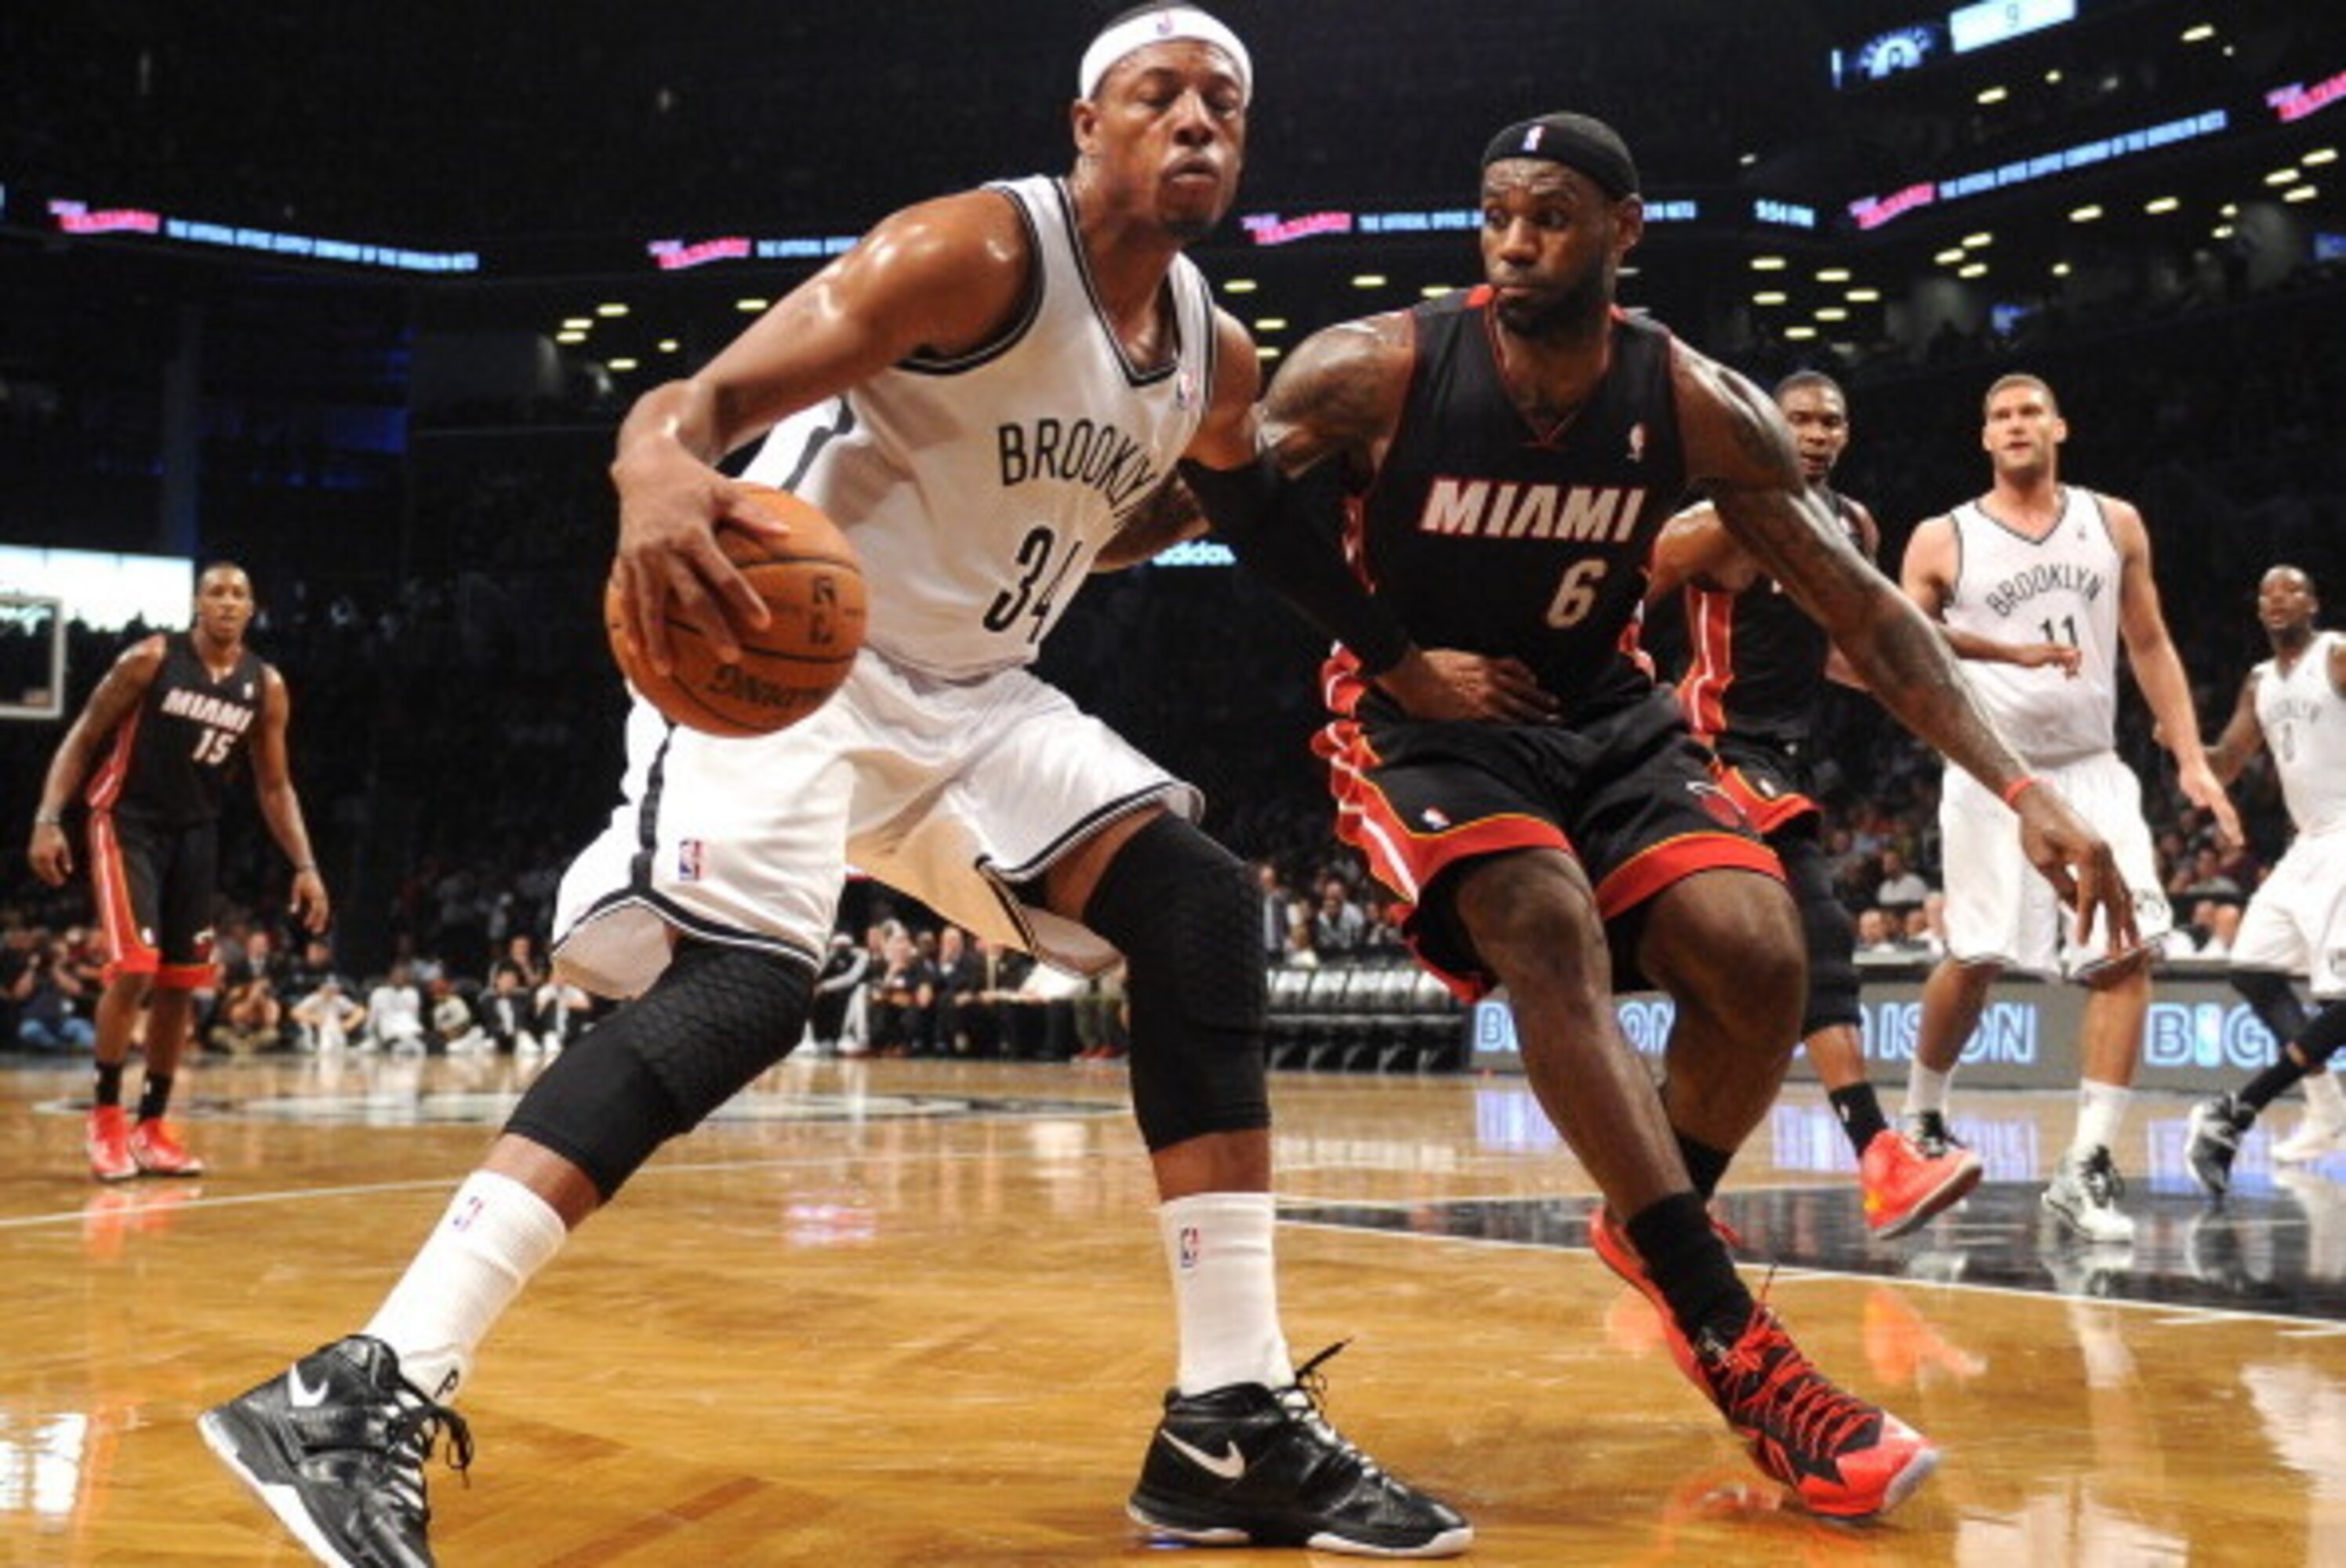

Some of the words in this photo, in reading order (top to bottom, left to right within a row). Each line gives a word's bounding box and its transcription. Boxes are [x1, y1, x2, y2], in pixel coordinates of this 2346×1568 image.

[1419, 478, 1646, 543] MIAMI
[982, 526, 1083, 644] 34
[1546, 558, 1608, 628] 6
[1985, 562, 2107, 619] BROOKLYN
[161, 687, 255, 734] MIAMI
[193, 728, 237, 766] 15
[2144, 1003, 2280, 1069] BIG
